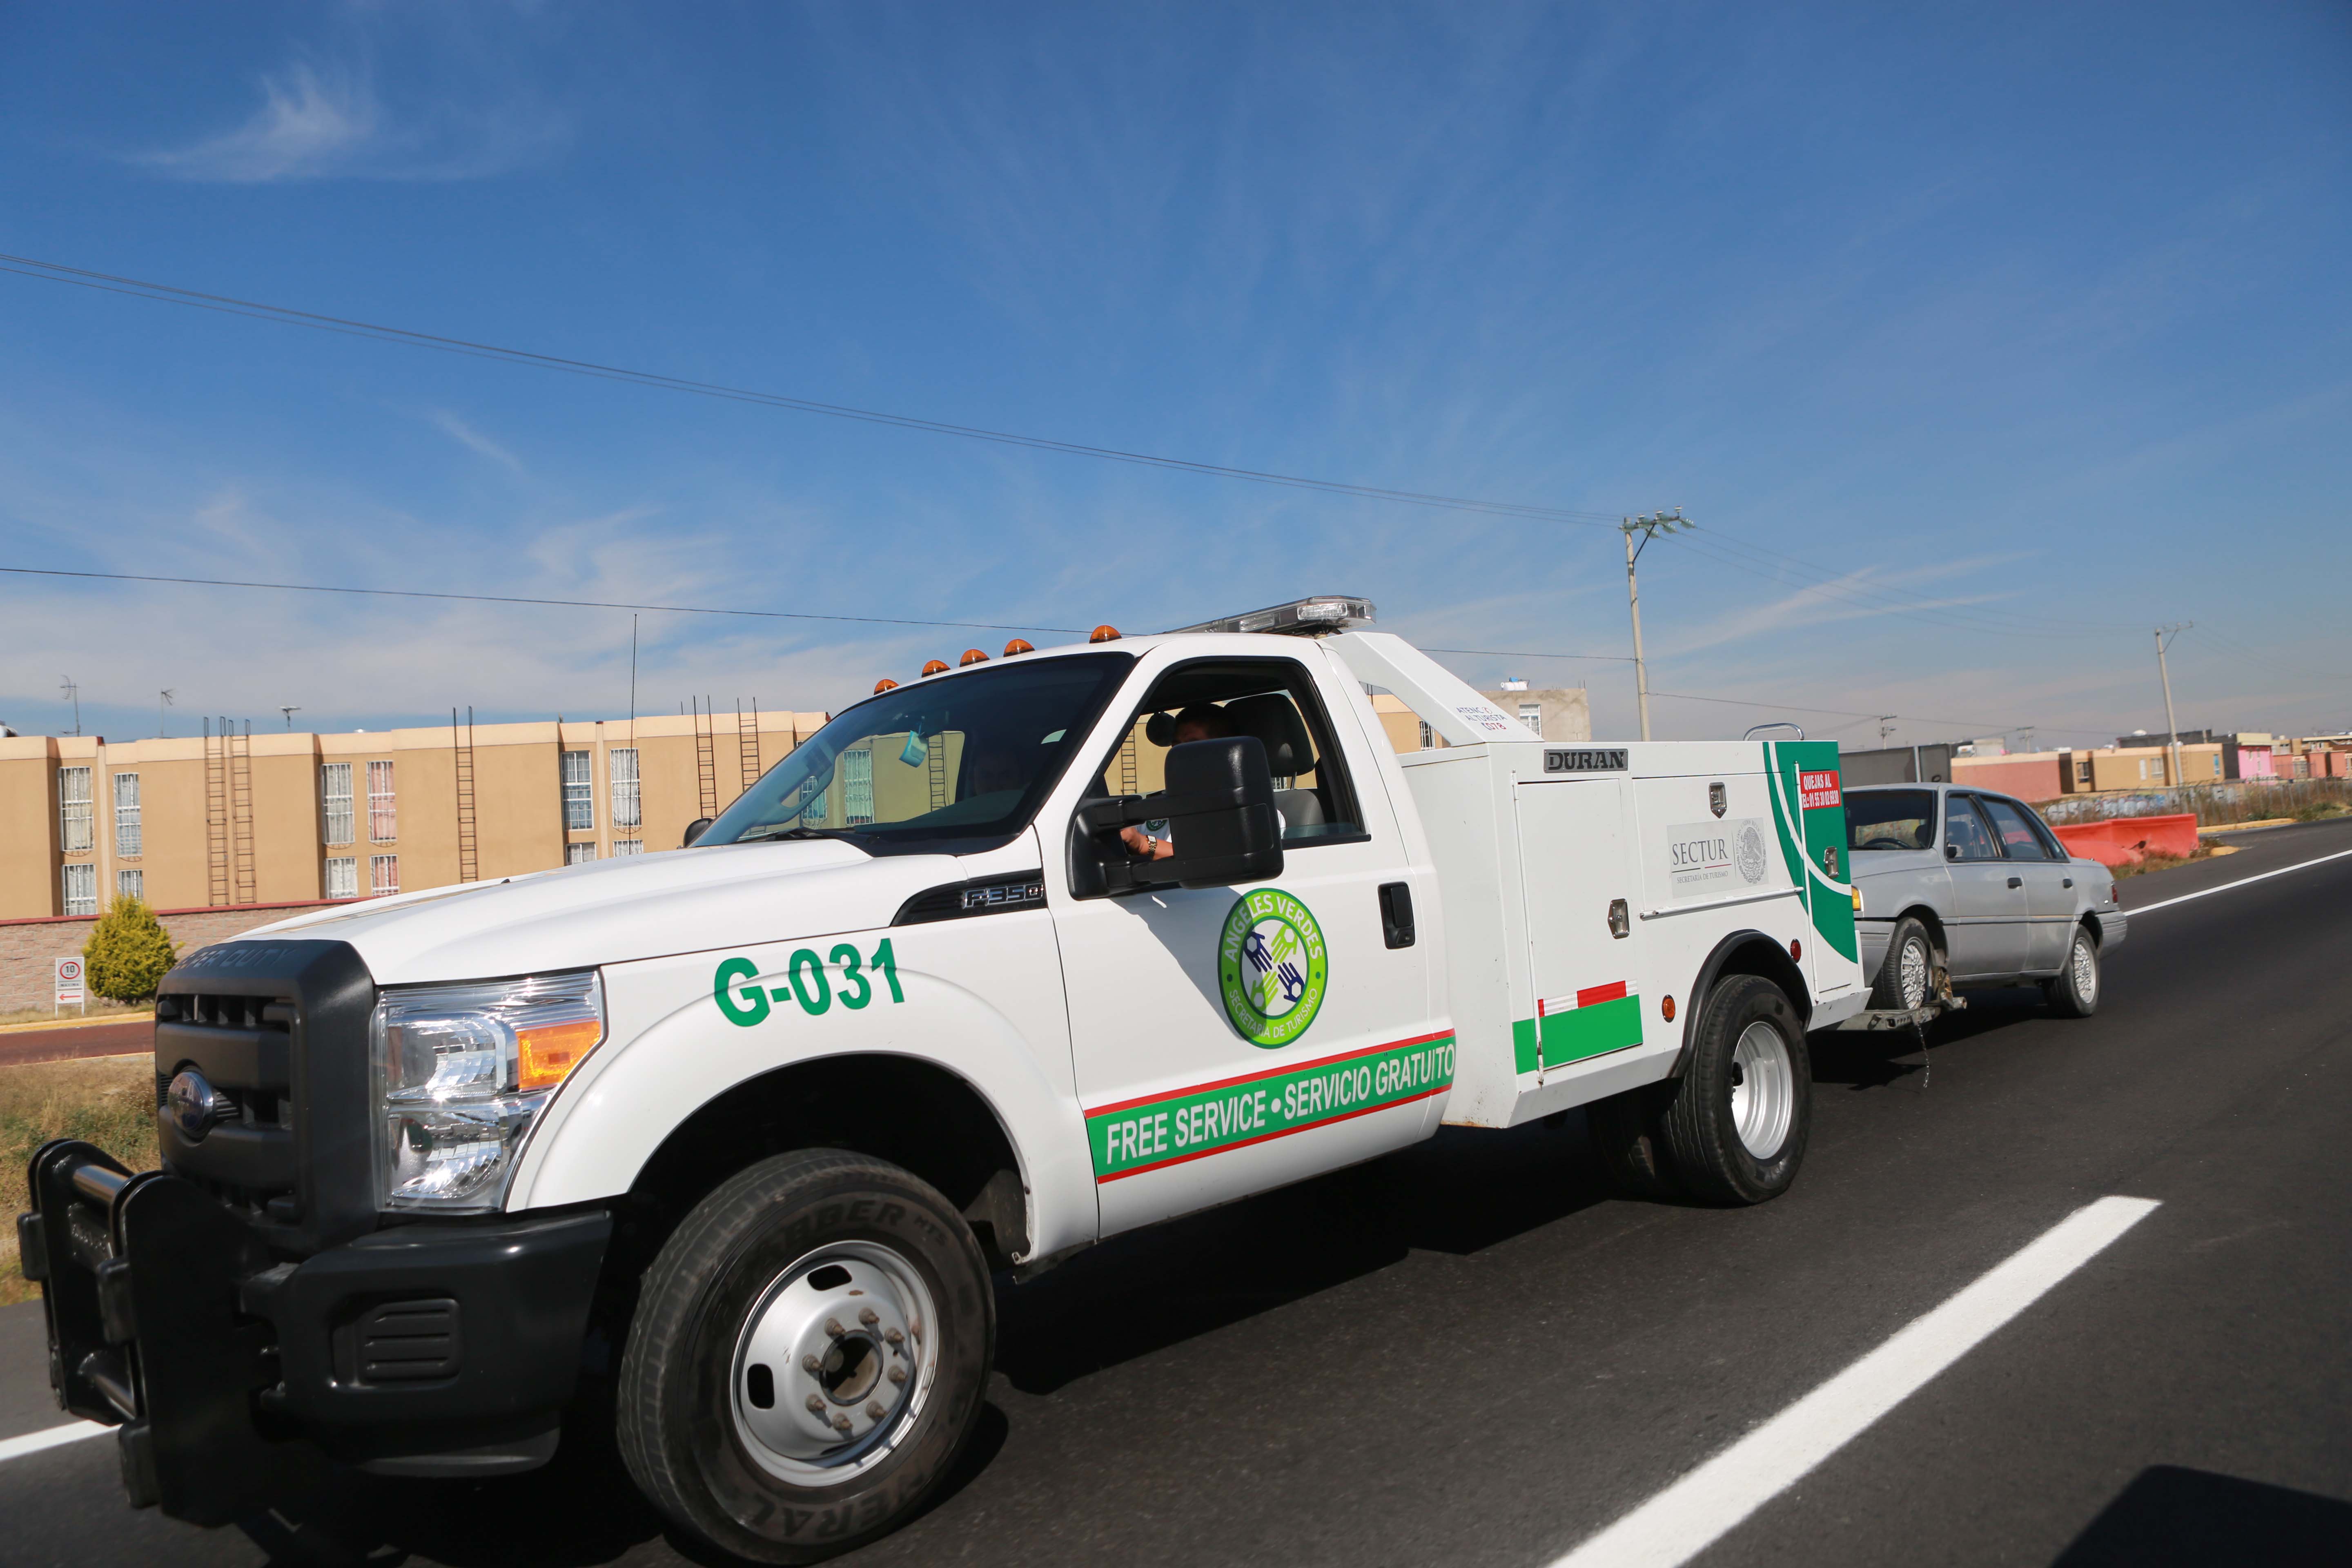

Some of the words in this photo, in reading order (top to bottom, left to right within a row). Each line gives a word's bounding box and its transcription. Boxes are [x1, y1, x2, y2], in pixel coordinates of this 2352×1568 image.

[1548, 751, 1624, 770] DURAN
[1803, 774, 1824, 791] QUEJAS
[1825, 773, 1832, 788] AL
[1809, 793, 1815, 807] 01
[1814, 792, 1820, 806] 55
[1824, 791, 1830, 805] 02
[1672, 838, 1728, 865] SECTUR
[1709, 871, 1728, 879] TURISMO
[1225, 894, 1274, 963] ANGELES
[1276, 896, 1323, 960] VERDES
[219, 949, 297, 968] DUTY
[714, 938, 905, 1027] G-031
[1273, 1025, 1285, 1038] DE
[1285, 988, 1318, 1033] TURISMO
[1107, 1112, 1168, 1165] FREE
[1174, 1090, 1266, 1148] SERVICE
[1283, 1068, 1371, 1120] SERVICIO
[1375, 1043, 1456, 1096] GRATUITO
